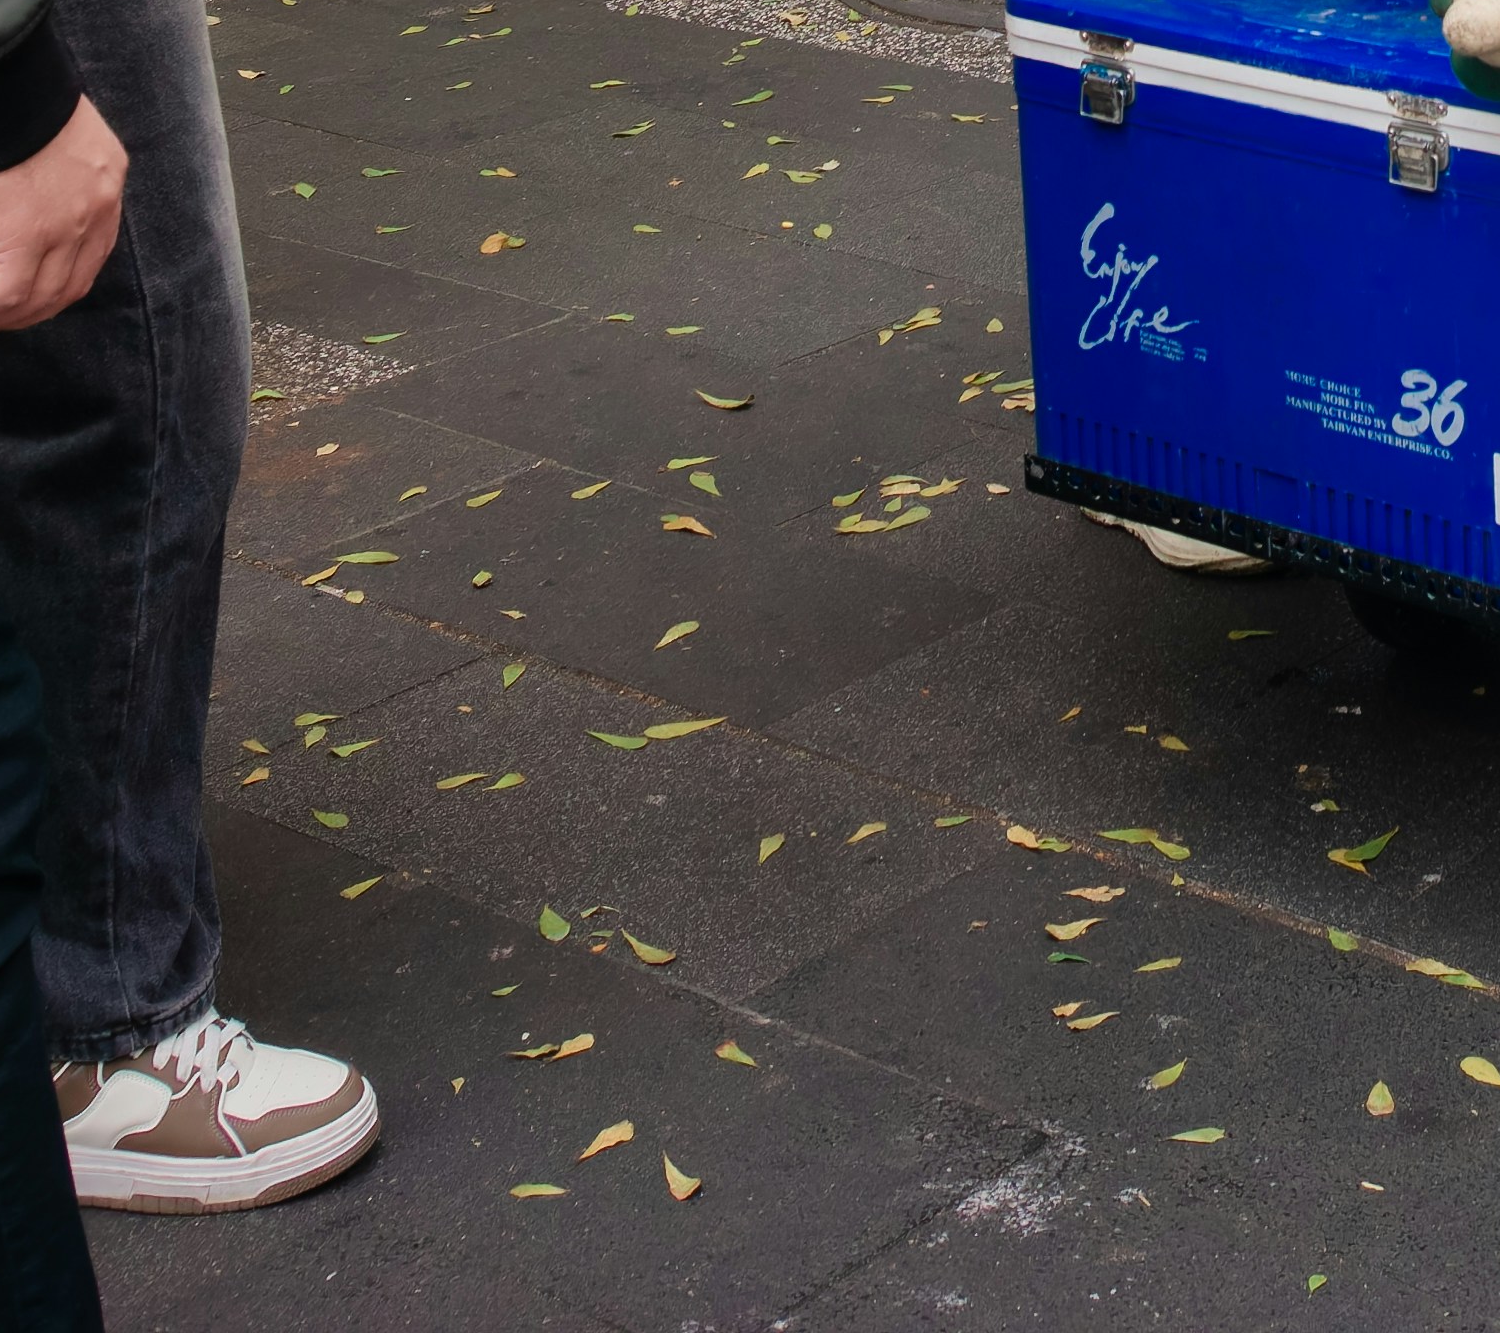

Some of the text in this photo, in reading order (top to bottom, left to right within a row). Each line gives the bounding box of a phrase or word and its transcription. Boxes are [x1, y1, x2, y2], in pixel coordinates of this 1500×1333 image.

[1080, 202, 1159, 315] Enjoy
[1285, 369, 1361, 398] MORE CHOICE
[1285, 394, 1372, 426] MANUFACTURED
[1320, 391, 1375, 415] MORE FUN
[1392, 368, 1468, 447] 36
[1367, 429, 1433, 456] ENTERPRISE
